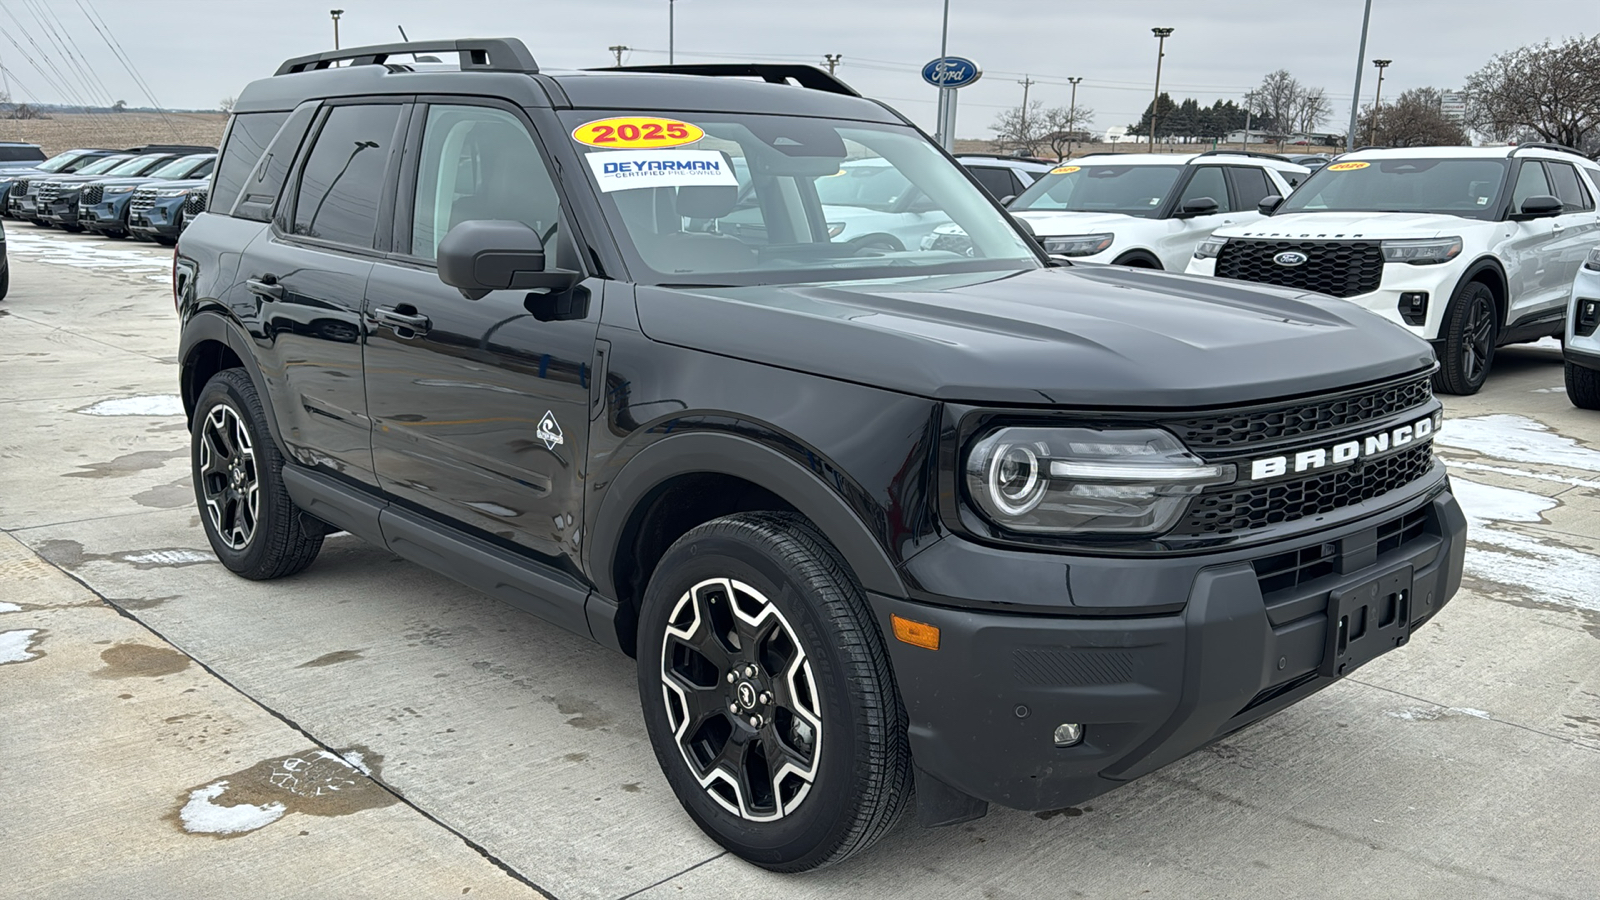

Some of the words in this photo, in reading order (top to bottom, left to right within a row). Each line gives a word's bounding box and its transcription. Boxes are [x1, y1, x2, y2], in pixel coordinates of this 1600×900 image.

[931, 62, 966, 81] Ford
[591, 123, 690, 143] 2025
[603, 160, 720, 174] DEYARMAN
[615, 170, 665, 178] CERTIFIED
[1280, 253, 1300, 263] Ford
[1251, 417, 1432, 480] BRONCO
